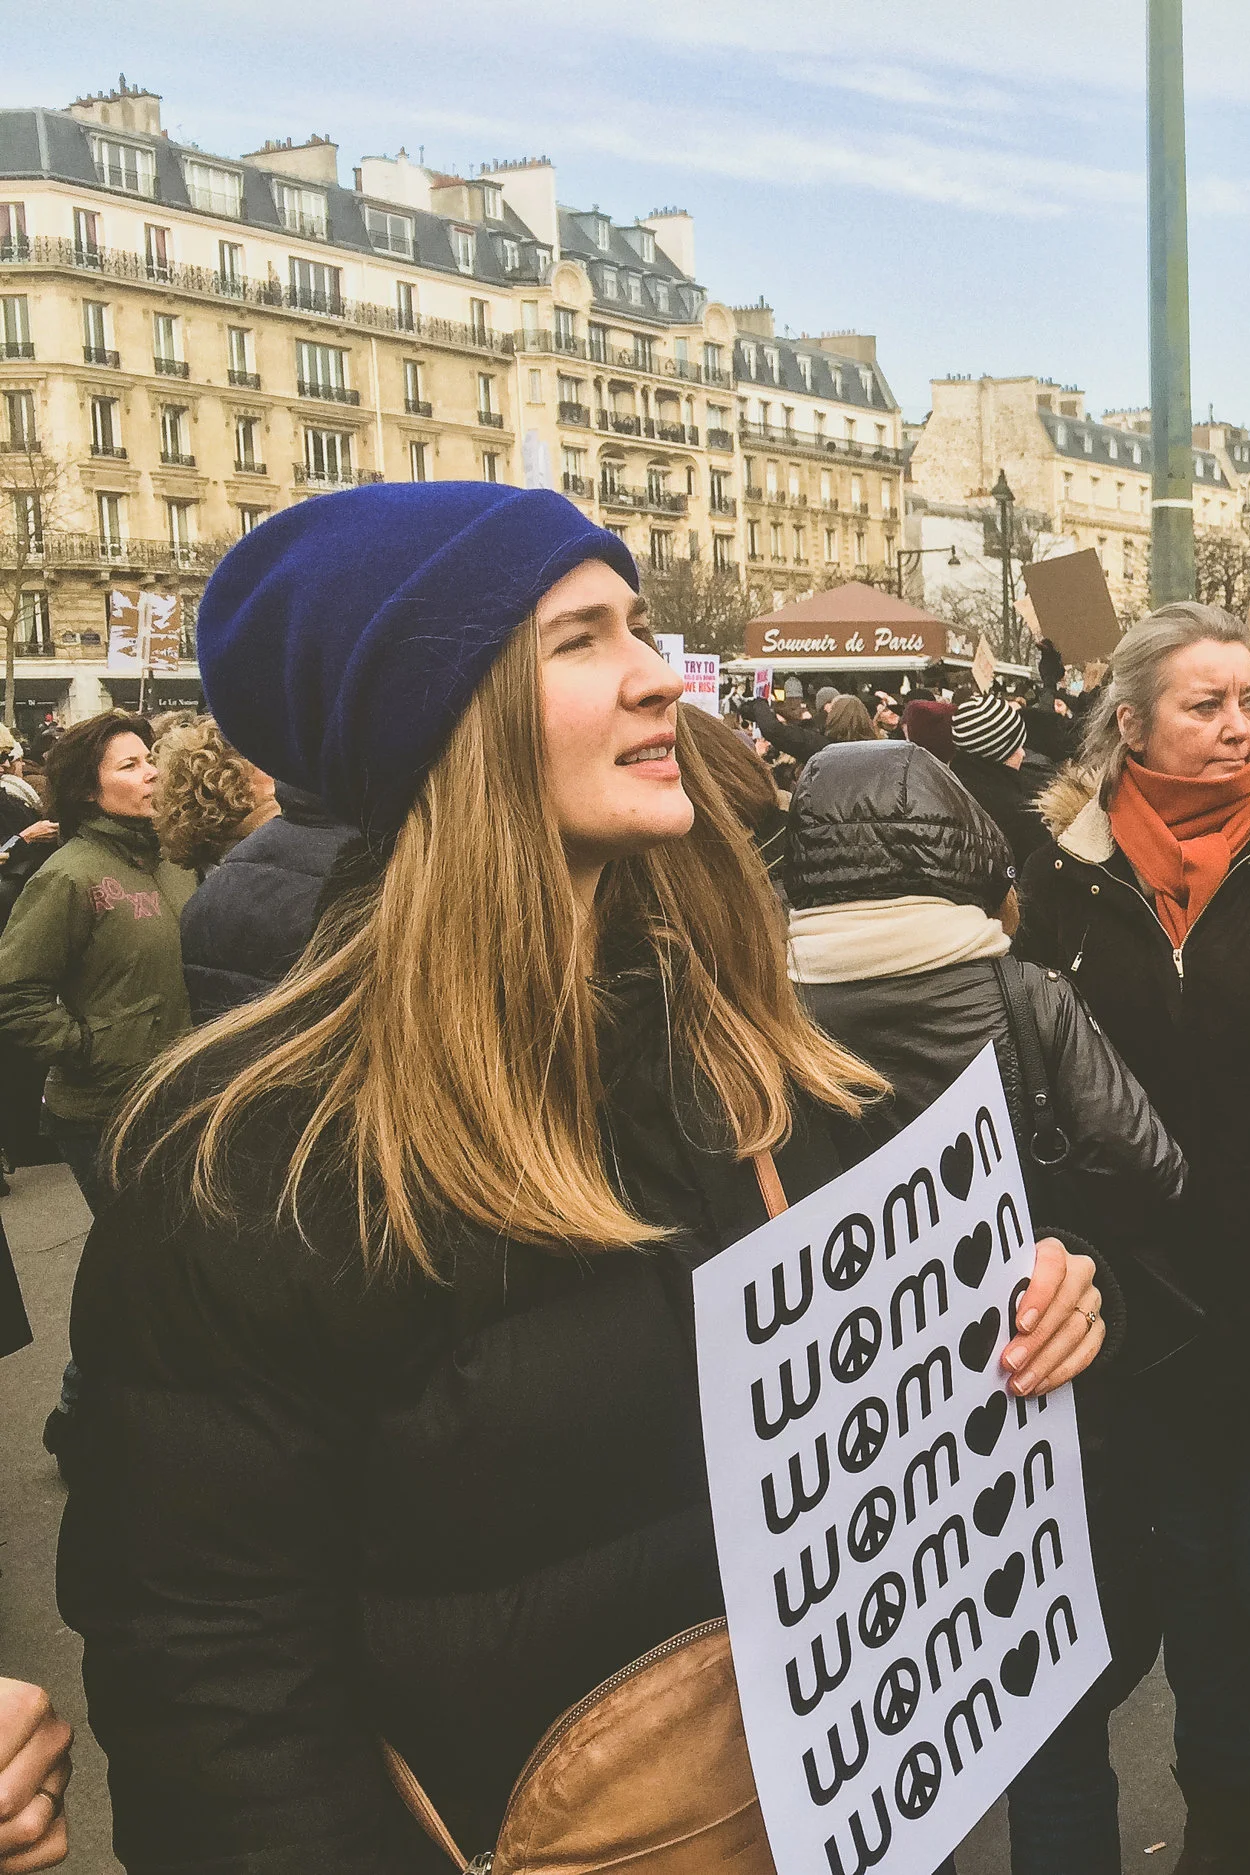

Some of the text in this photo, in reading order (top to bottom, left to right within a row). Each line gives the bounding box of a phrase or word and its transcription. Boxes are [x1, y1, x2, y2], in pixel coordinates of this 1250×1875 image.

[762, 627, 925, 653] Souvenir de Paris
[684, 660, 715, 674] TRY TO
[684, 681, 716, 693] WE RISE
[87, 876, 161, 920] ROXY
[774, 1390, 1047, 1627] wom
